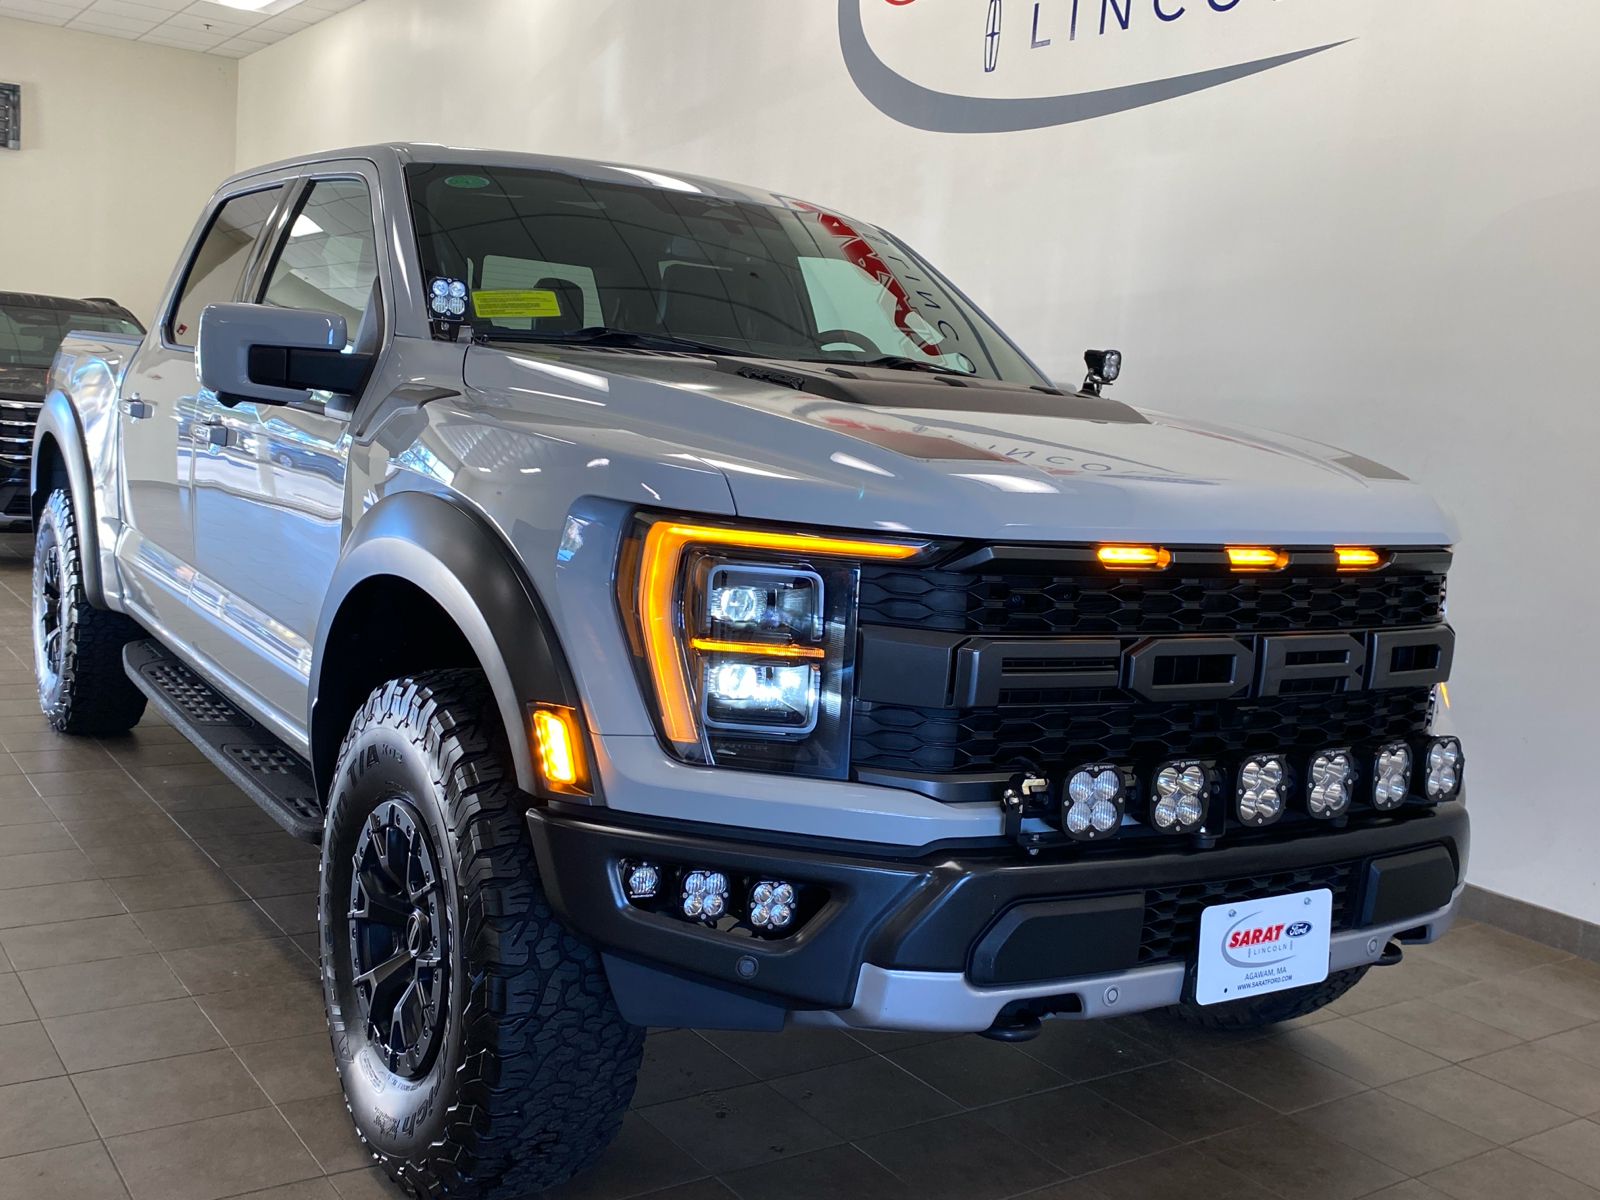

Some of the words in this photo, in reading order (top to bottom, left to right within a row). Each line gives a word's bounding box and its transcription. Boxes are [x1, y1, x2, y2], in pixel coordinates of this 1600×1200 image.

[958, 625, 1456, 707] FORD
[347, 743, 380, 787] T/A
[1228, 923, 1286, 948] SARAT
[1289, 924, 1309, 936] Ford
[1237, 974, 1293, 991] WWW.SARATFORD.COM
[1244, 970, 1276, 981] AGAWAM,
[1276, 966, 1287, 974] MA
